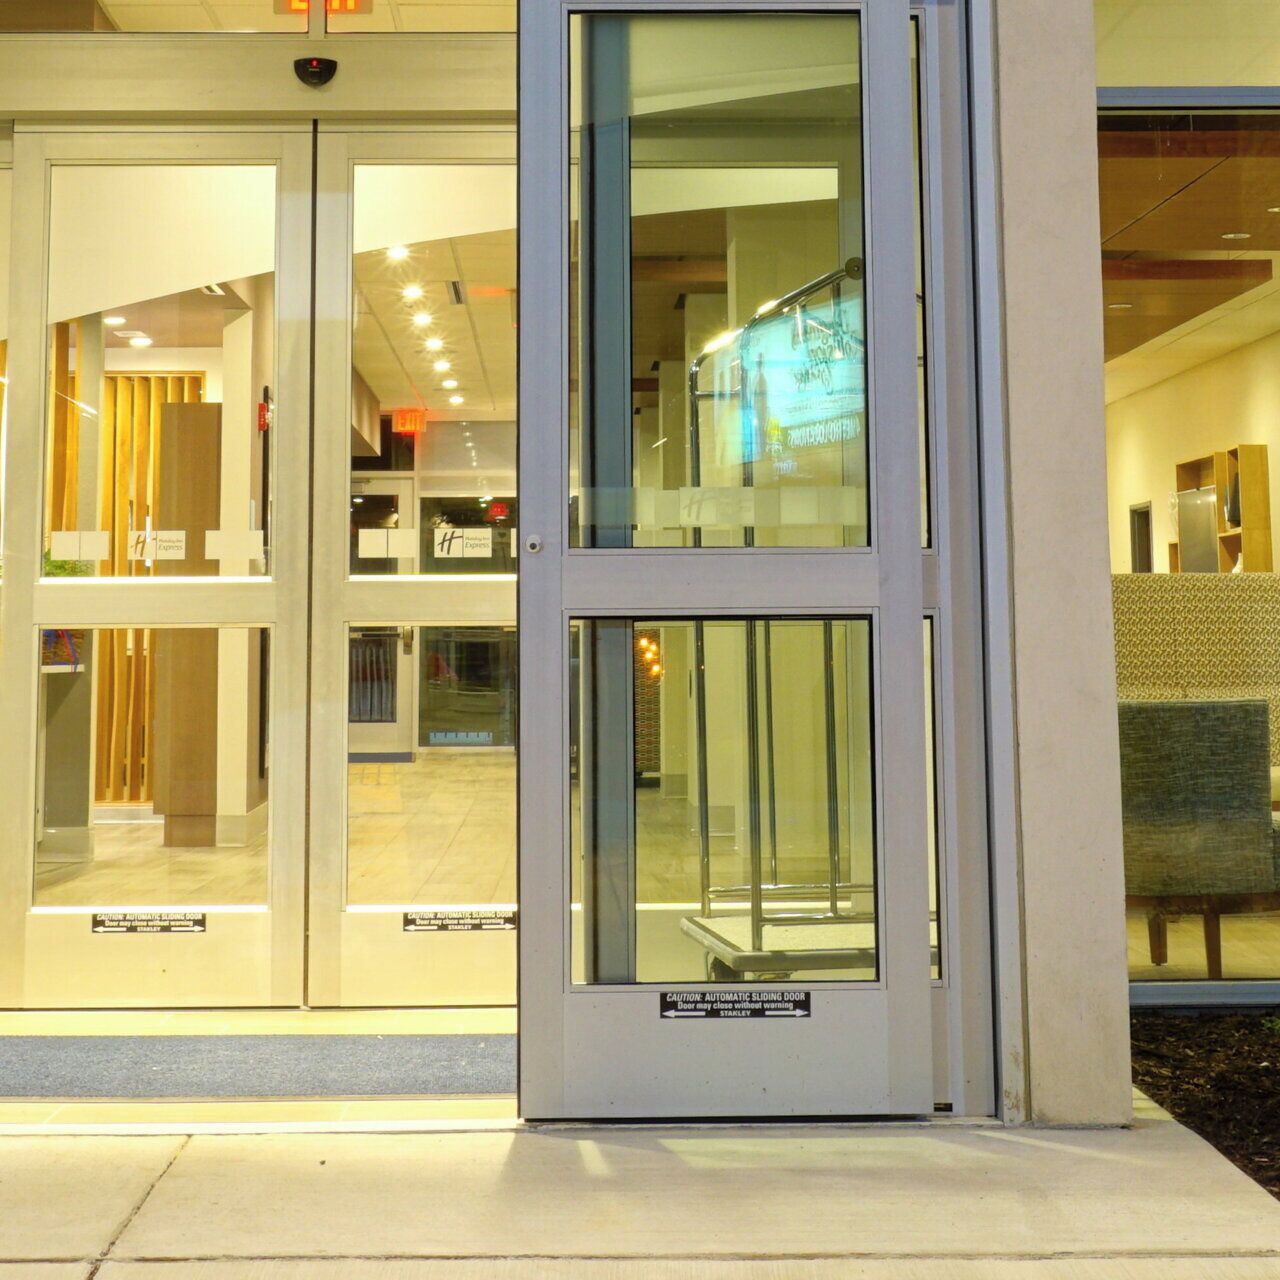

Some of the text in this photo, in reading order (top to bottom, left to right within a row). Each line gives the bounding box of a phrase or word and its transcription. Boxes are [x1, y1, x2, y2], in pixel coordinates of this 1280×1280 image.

[667, 992, 805, 1002] CAUTION: AUTOMATIC SLIDING DOOR
[678, 1002, 695, 1010] Door
[696, 1003, 711, 1011] may
[764, 1002, 794, 1010] warning
